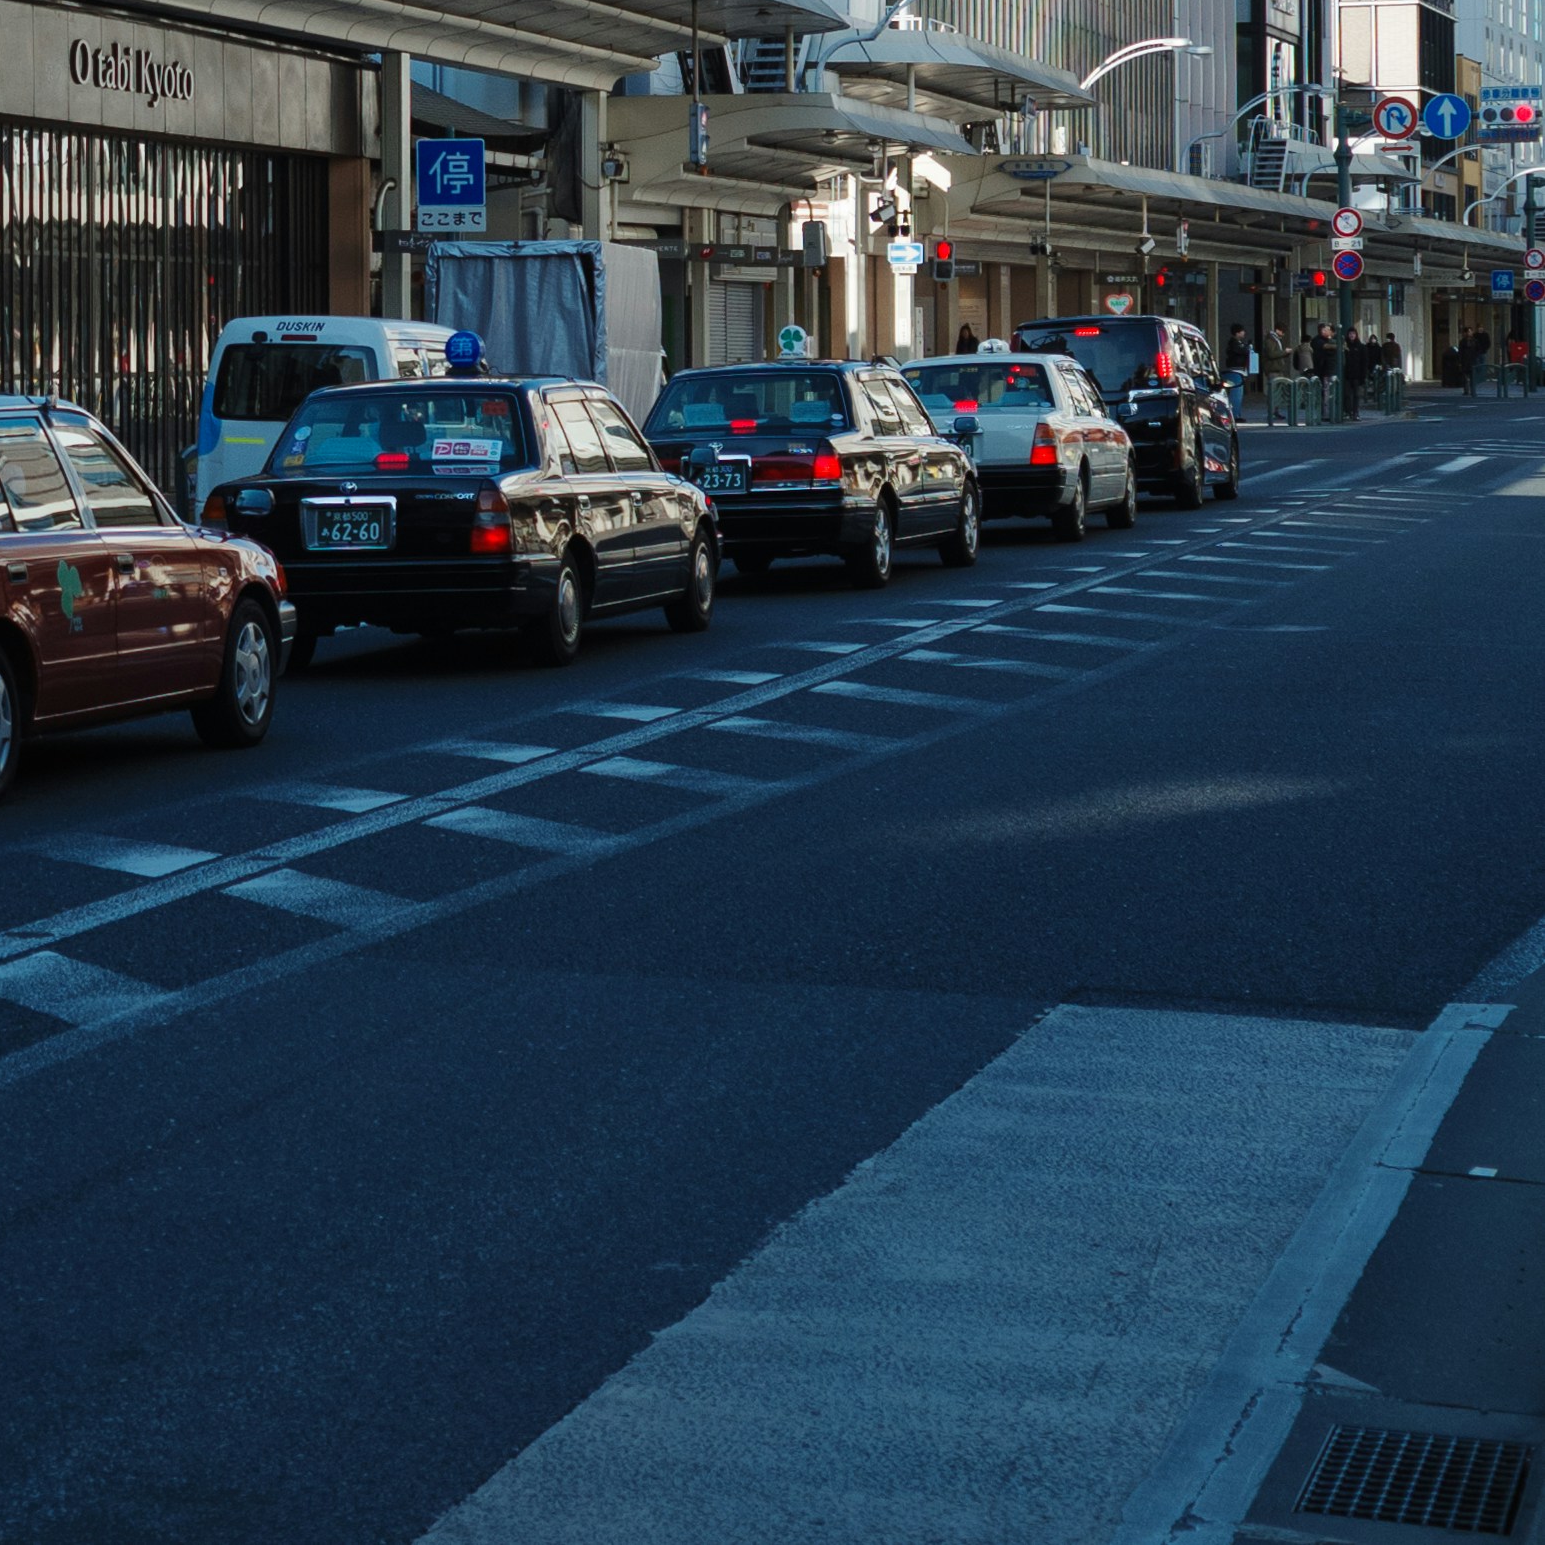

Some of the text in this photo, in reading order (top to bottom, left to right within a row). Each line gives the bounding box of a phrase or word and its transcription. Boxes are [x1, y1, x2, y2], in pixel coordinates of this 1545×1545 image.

[137, 50, 194, 108] Kyoto
[428, 151, 474, 195] 停
[421, 211, 483, 227] ここまで
[276, 321, 326, 332] DUSKIN
[703, 473, 742, 489] 23-73
[331, 522, 380, 541] 62-60
